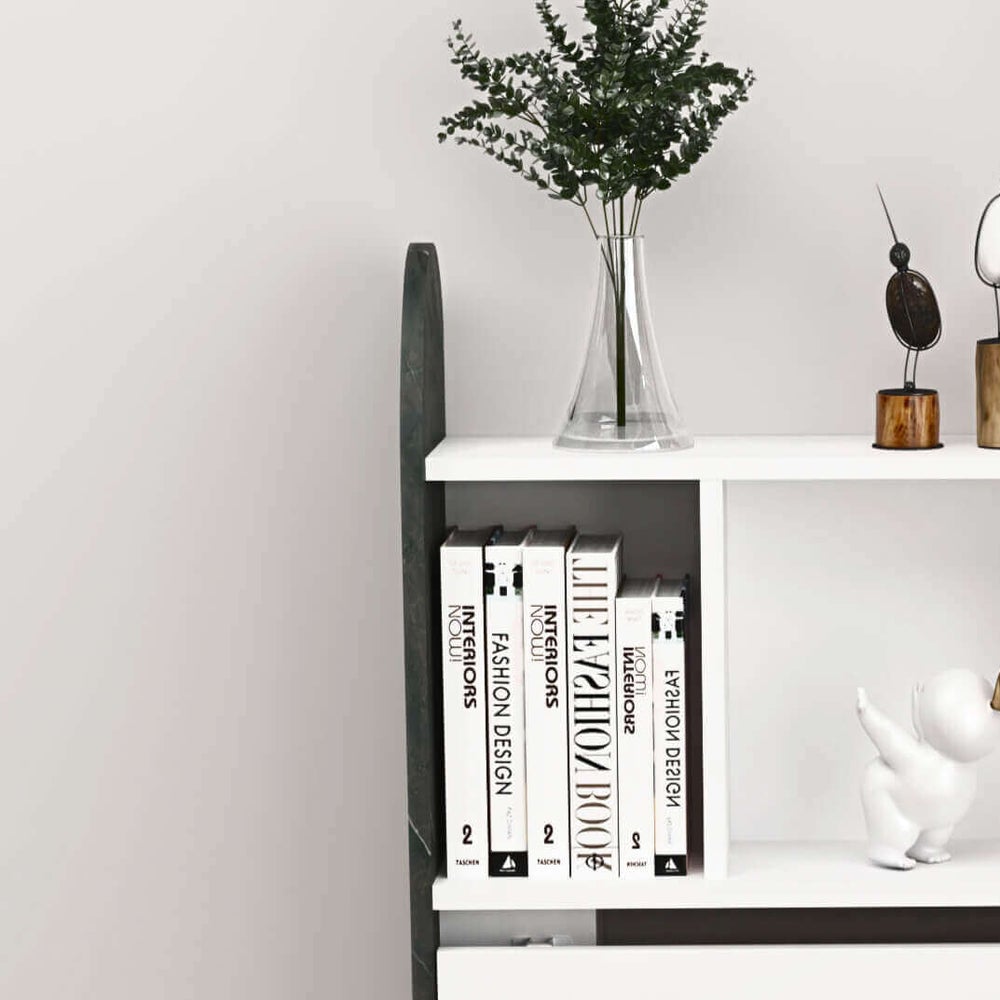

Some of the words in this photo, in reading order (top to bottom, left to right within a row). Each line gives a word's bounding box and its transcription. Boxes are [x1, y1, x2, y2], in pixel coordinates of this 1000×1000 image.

[461, 604, 477, 709] INTERIORS
[491, 633, 511, 717] FASHION
[543, 604, 559, 709] INTERIORS
[493, 725, 513, 795] DESIGN
[462, 824, 473, 845] 2
[543, 824, 555, 845] 2
[455, 859, 480, 867] TASCHEN
[537, 858, 561, 867] TASCHEN
